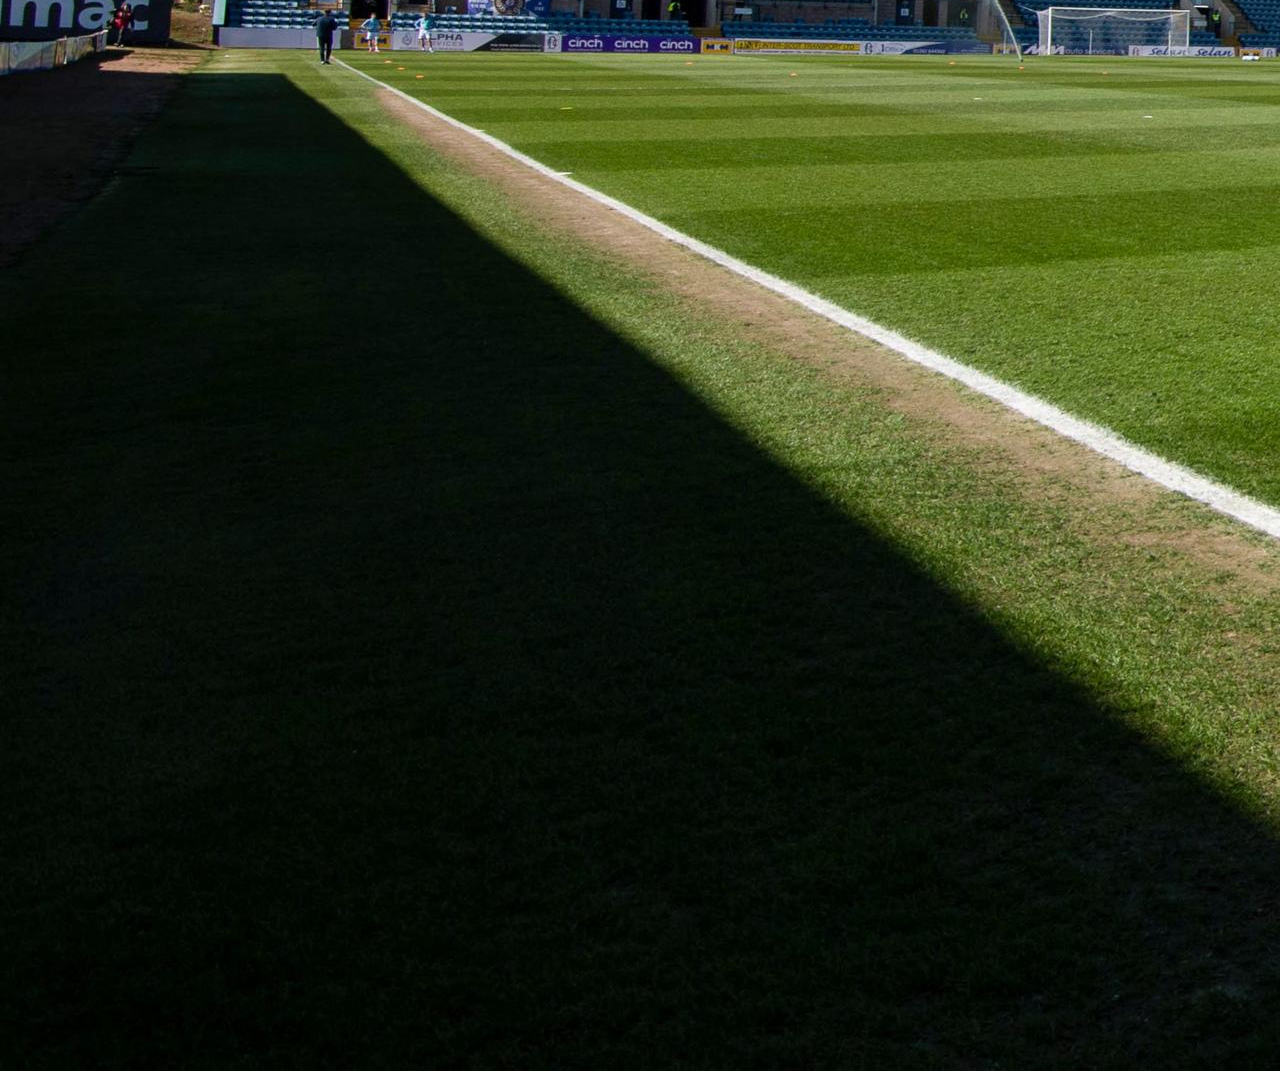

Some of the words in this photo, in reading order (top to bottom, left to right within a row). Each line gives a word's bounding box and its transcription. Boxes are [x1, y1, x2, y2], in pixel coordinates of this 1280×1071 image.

[568, 37, 603, 49] cinch
[614, 38, 648, 49] cinch
[659, 39, 693, 50] cinch
[1195, 46, 1233, 57] Selan
